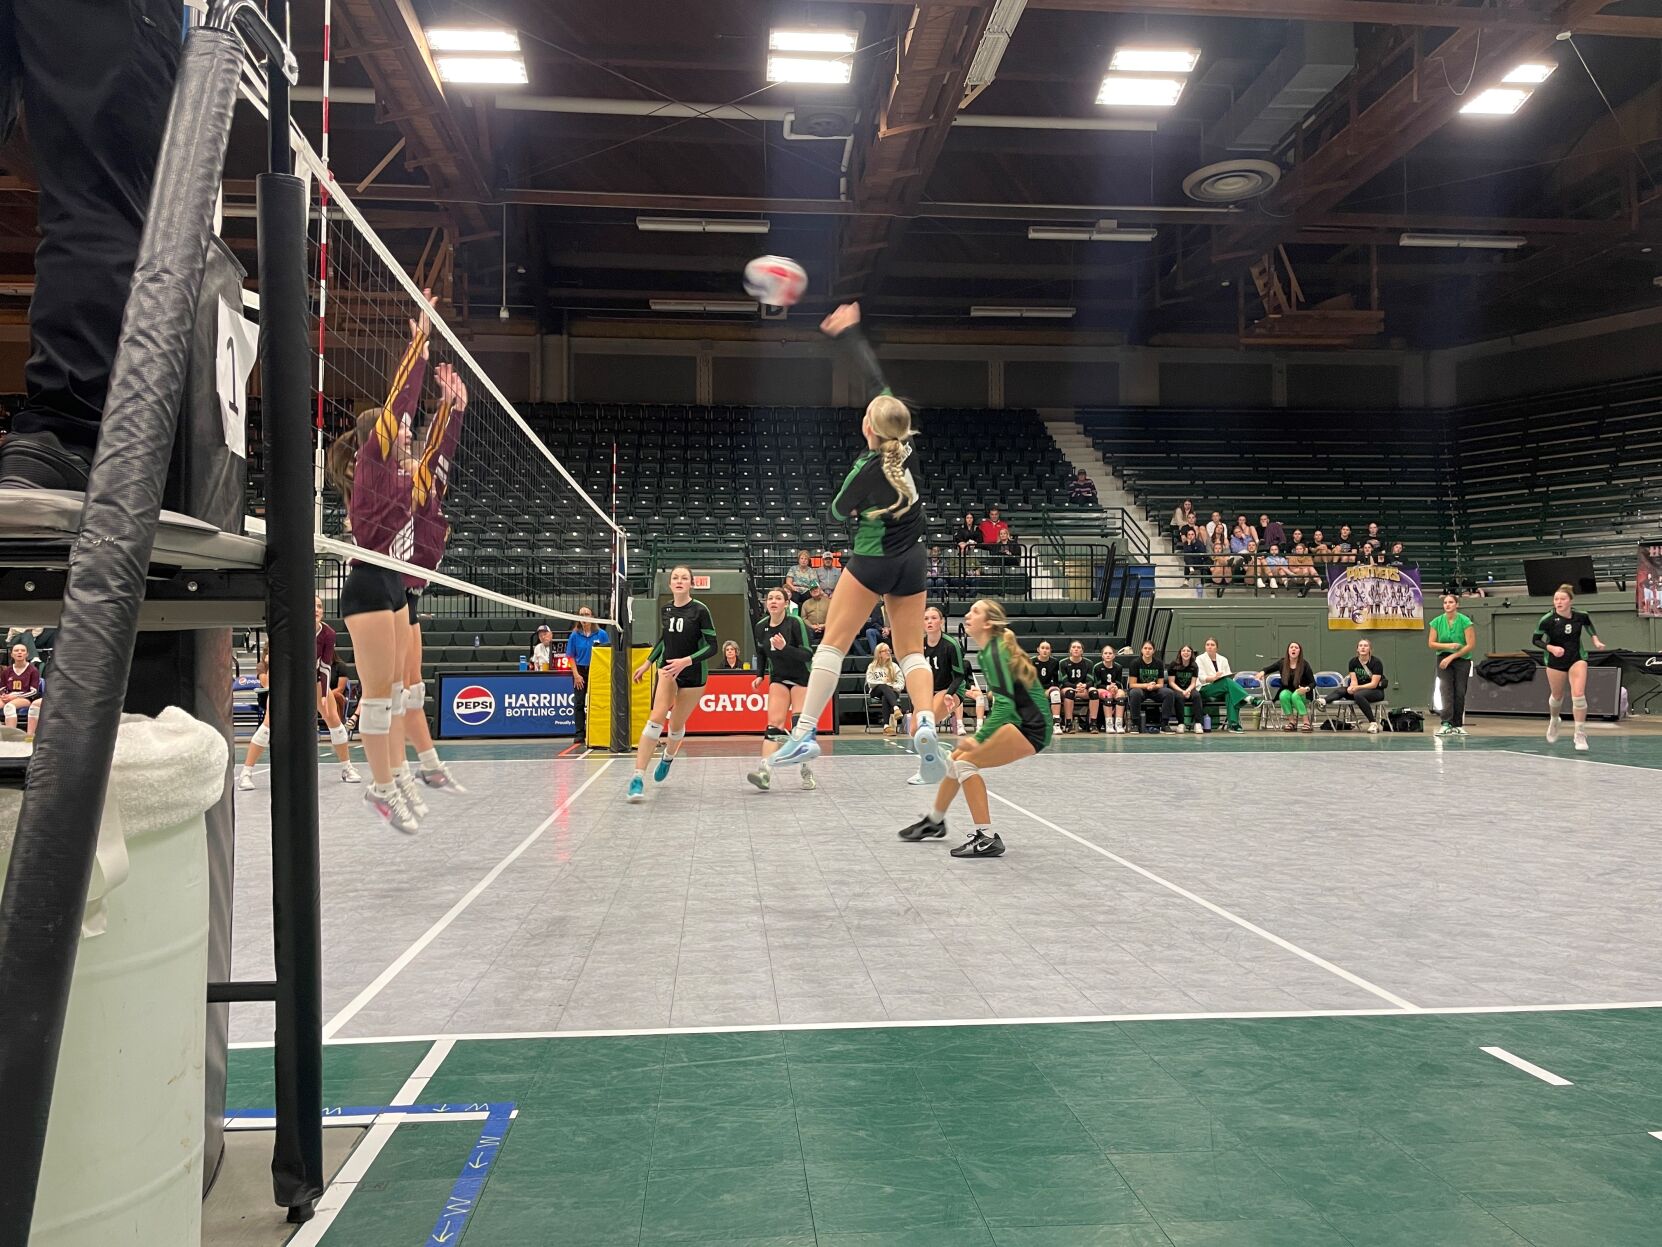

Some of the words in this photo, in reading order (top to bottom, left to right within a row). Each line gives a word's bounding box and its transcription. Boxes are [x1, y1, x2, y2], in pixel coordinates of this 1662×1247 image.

[226, 336, 239, 416] 1
[668, 617, 684, 632] 10
[1041, 667, 1047, 677] 6
[1071, 669, 1081, 678] 13
[456, 701, 492, 710] PEPSI
[505, 707, 556, 717] BOTTLING
